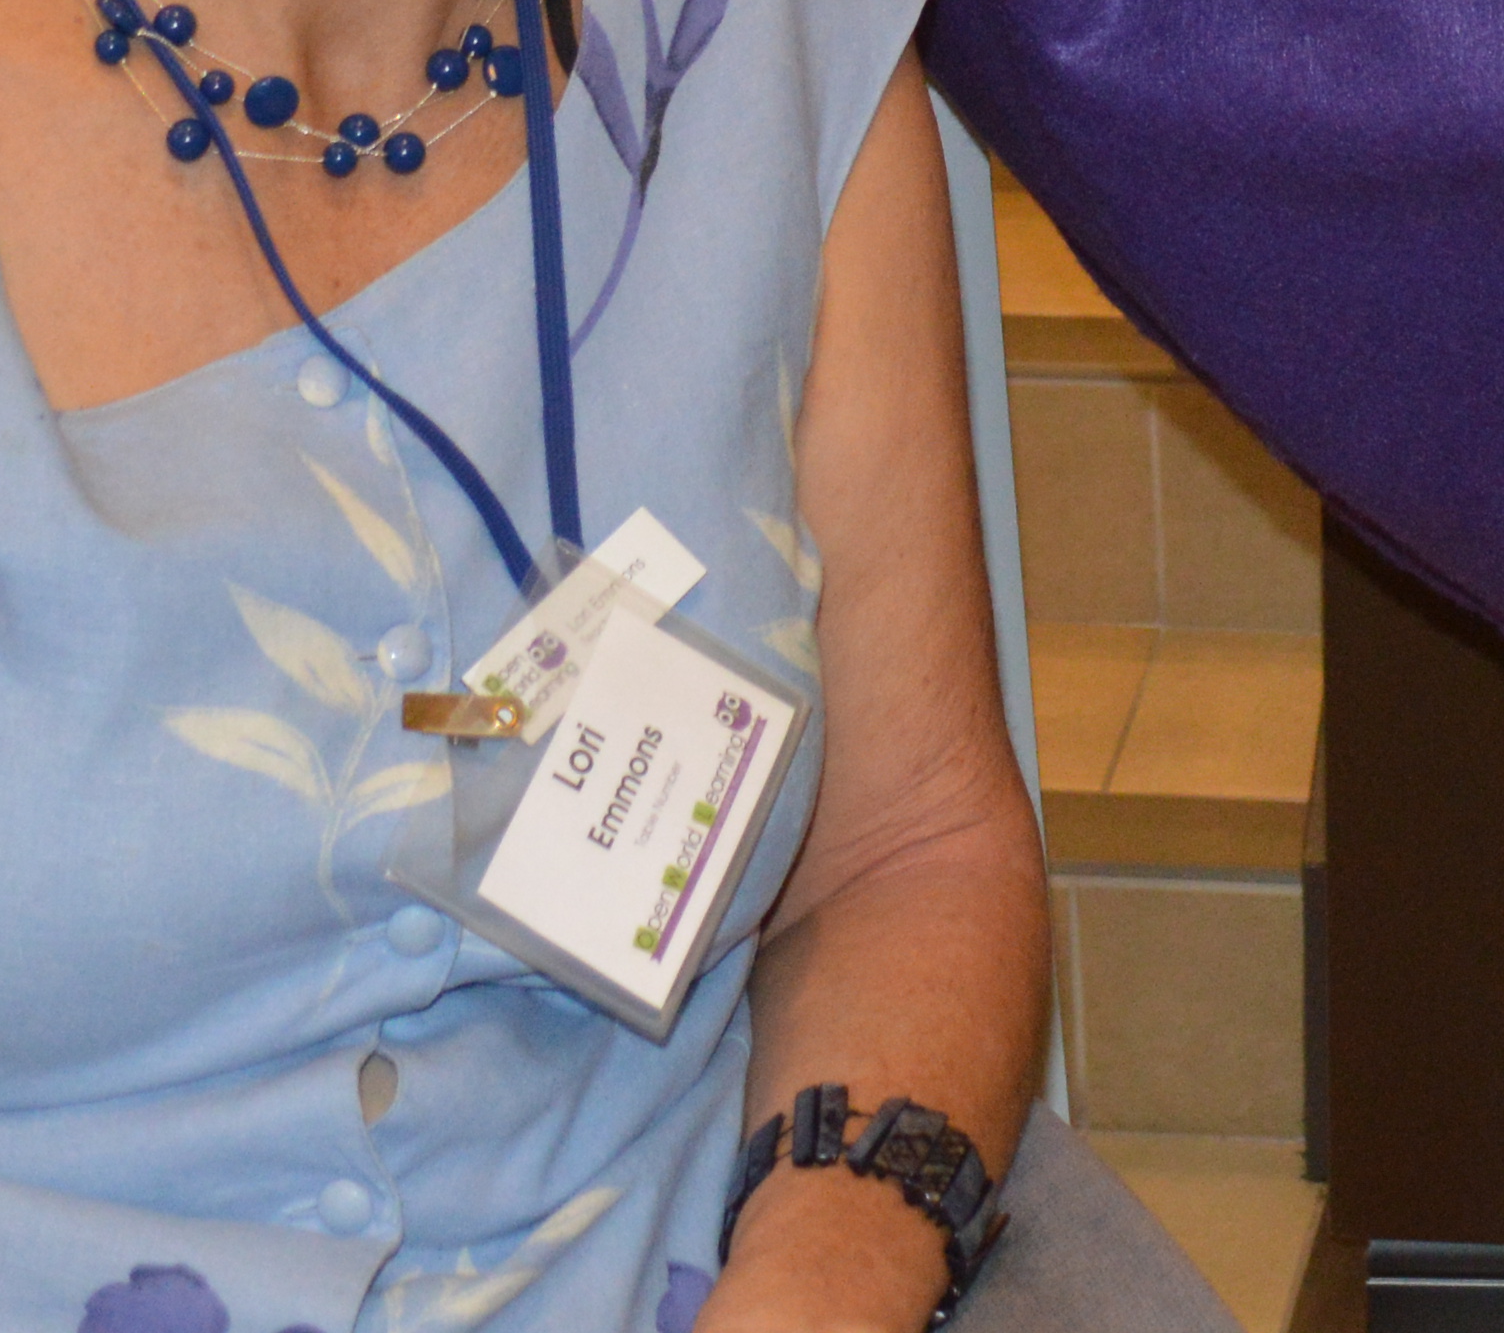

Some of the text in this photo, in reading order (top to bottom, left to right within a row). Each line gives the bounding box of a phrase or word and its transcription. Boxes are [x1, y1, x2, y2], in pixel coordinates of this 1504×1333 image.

[552, 722, 606, 792] Lori
[587, 725, 663, 851] Emmons
[632, 733, 748, 955] Open World Learning
